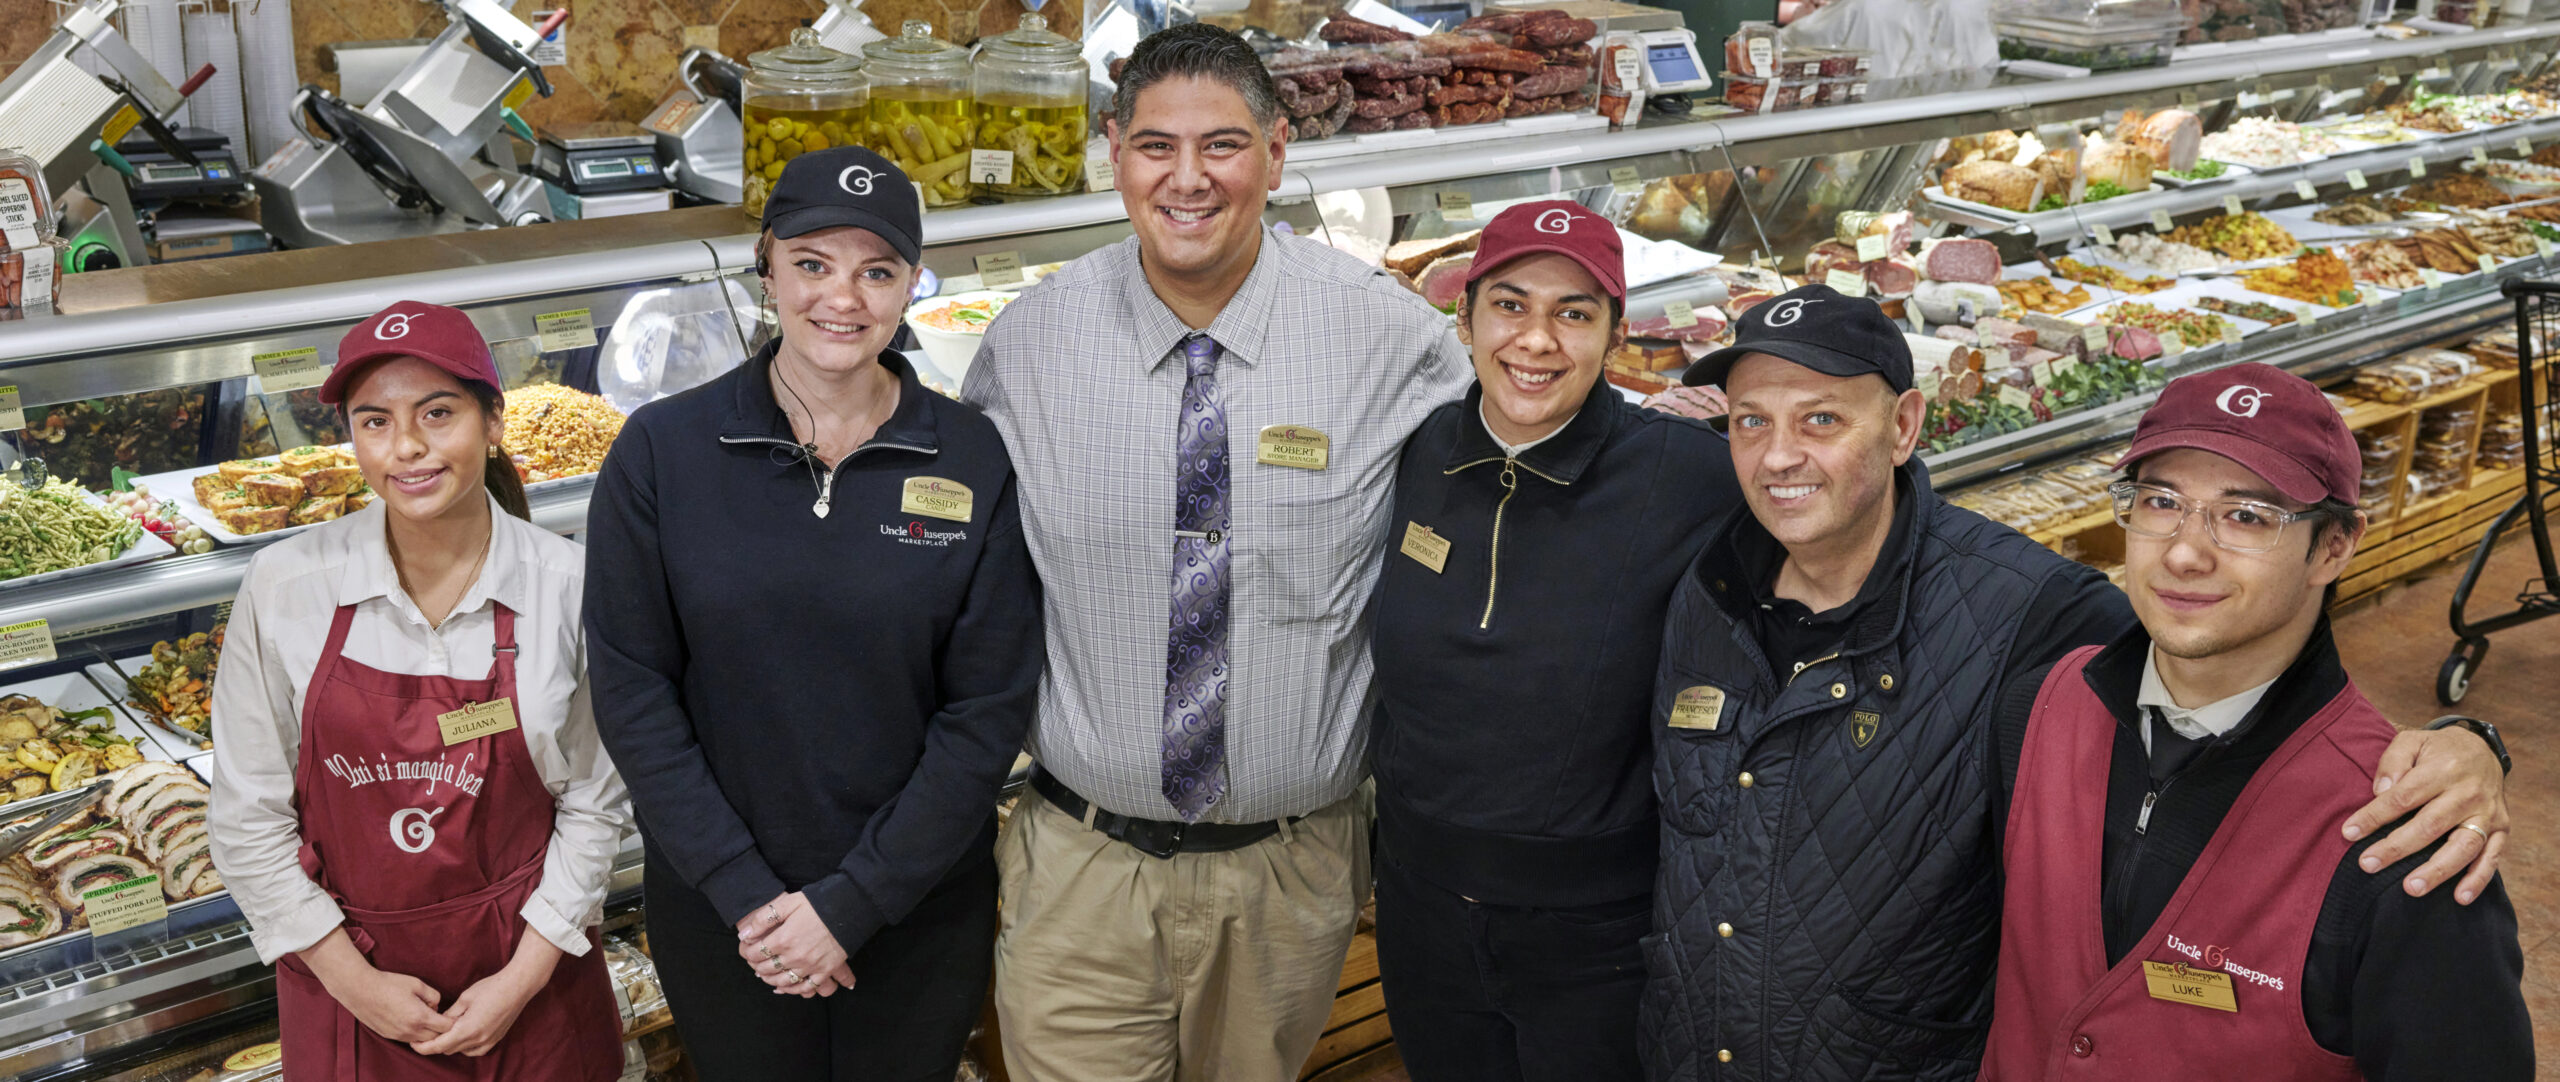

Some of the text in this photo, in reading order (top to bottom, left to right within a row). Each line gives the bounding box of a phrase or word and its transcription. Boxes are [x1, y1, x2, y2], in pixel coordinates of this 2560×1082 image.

[12, 193, 29, 202] SLICED
[6, 214, 25, 223] STICKS
[254, 346, 317, 361] SUMMER FAVORITES
[1273, 444, 1315, 457] ROBERT
[913, 482, 929, 490] Uncle
[916, 495, 958, 510] CASSIDY
[925, 504, 946, 512] CANDY
[880, 521, 966, 541] Uncle Giuseppe's
[898, 538, 948, 546] MARKETPLACE
[1407, 537, 1438, 562] VERONICA
[6, 619, 47, 632] FAVORITES
[0, 637, 46, 651] ON-ROASTED
[20, 643, 49, 653] THIGHS
[445, 710, 464, 720] Uncle
[1675, 703, 1718, 714] FRANCESCO
[1855, 712, 1876, 722] POLO
[452, 717, 497, 736] JULIANA
[376, 752, 393, 782] si
[395, 752, 455, 796] mangia
[83, 874, 157, 899] SPRING FAVORITES
[88, 906, 123, 921] STUFFED
[124, 901, 145, 912] PORK
[145, 895, 165, 906] LOIN
[2167, 934, 2284, 991] Uncle Giuseppe's
[2152, 962, 2223, 981] Uncle Giuseppe's
[2172, 983, 2204, 998] LUKE
